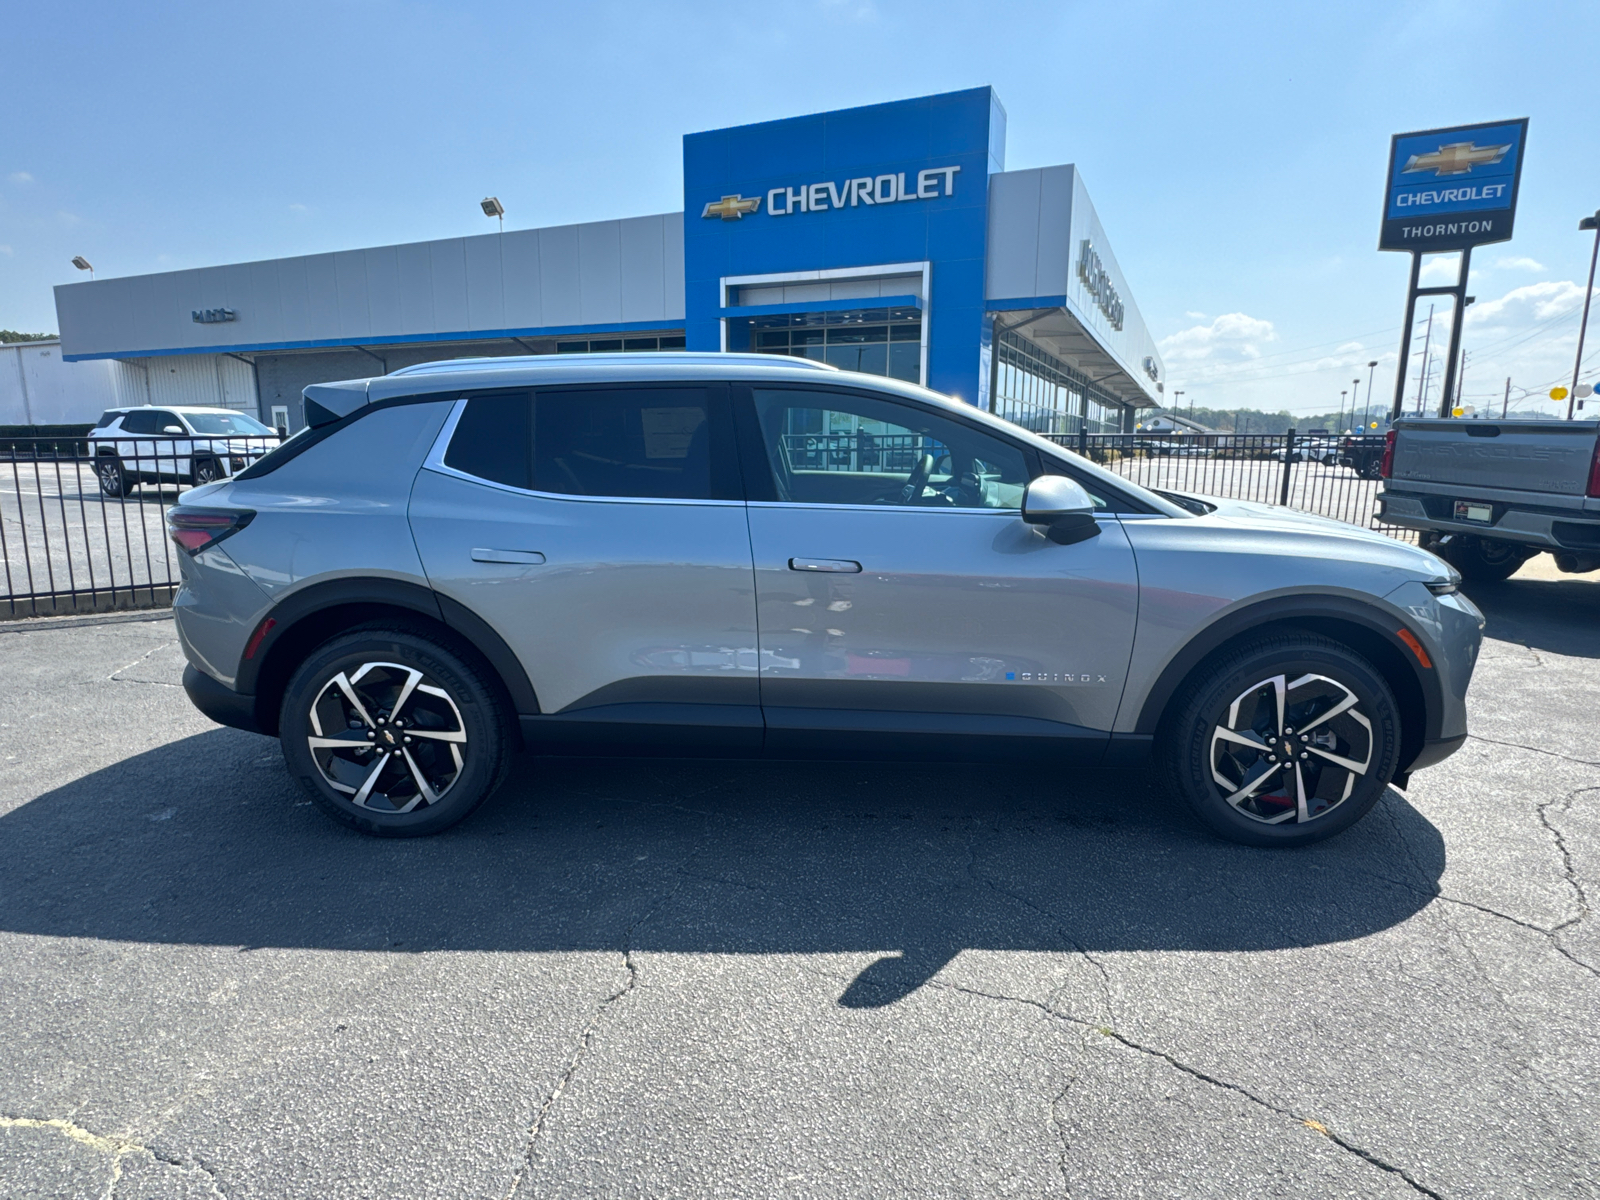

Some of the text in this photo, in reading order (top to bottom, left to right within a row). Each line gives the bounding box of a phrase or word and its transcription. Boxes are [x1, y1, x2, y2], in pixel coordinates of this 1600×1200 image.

[767, 165, 961, 216] CHEVROLET
[1396, 184, 1507, 207] CHEVROLET
[1402, 220, 1493, 239] THORNTON
[419, 658, 471, 702] MICHELIN
[1193, 718, 1206, 781] MICHELIN
[1378, 718, 1393, 780] MICHELIN
